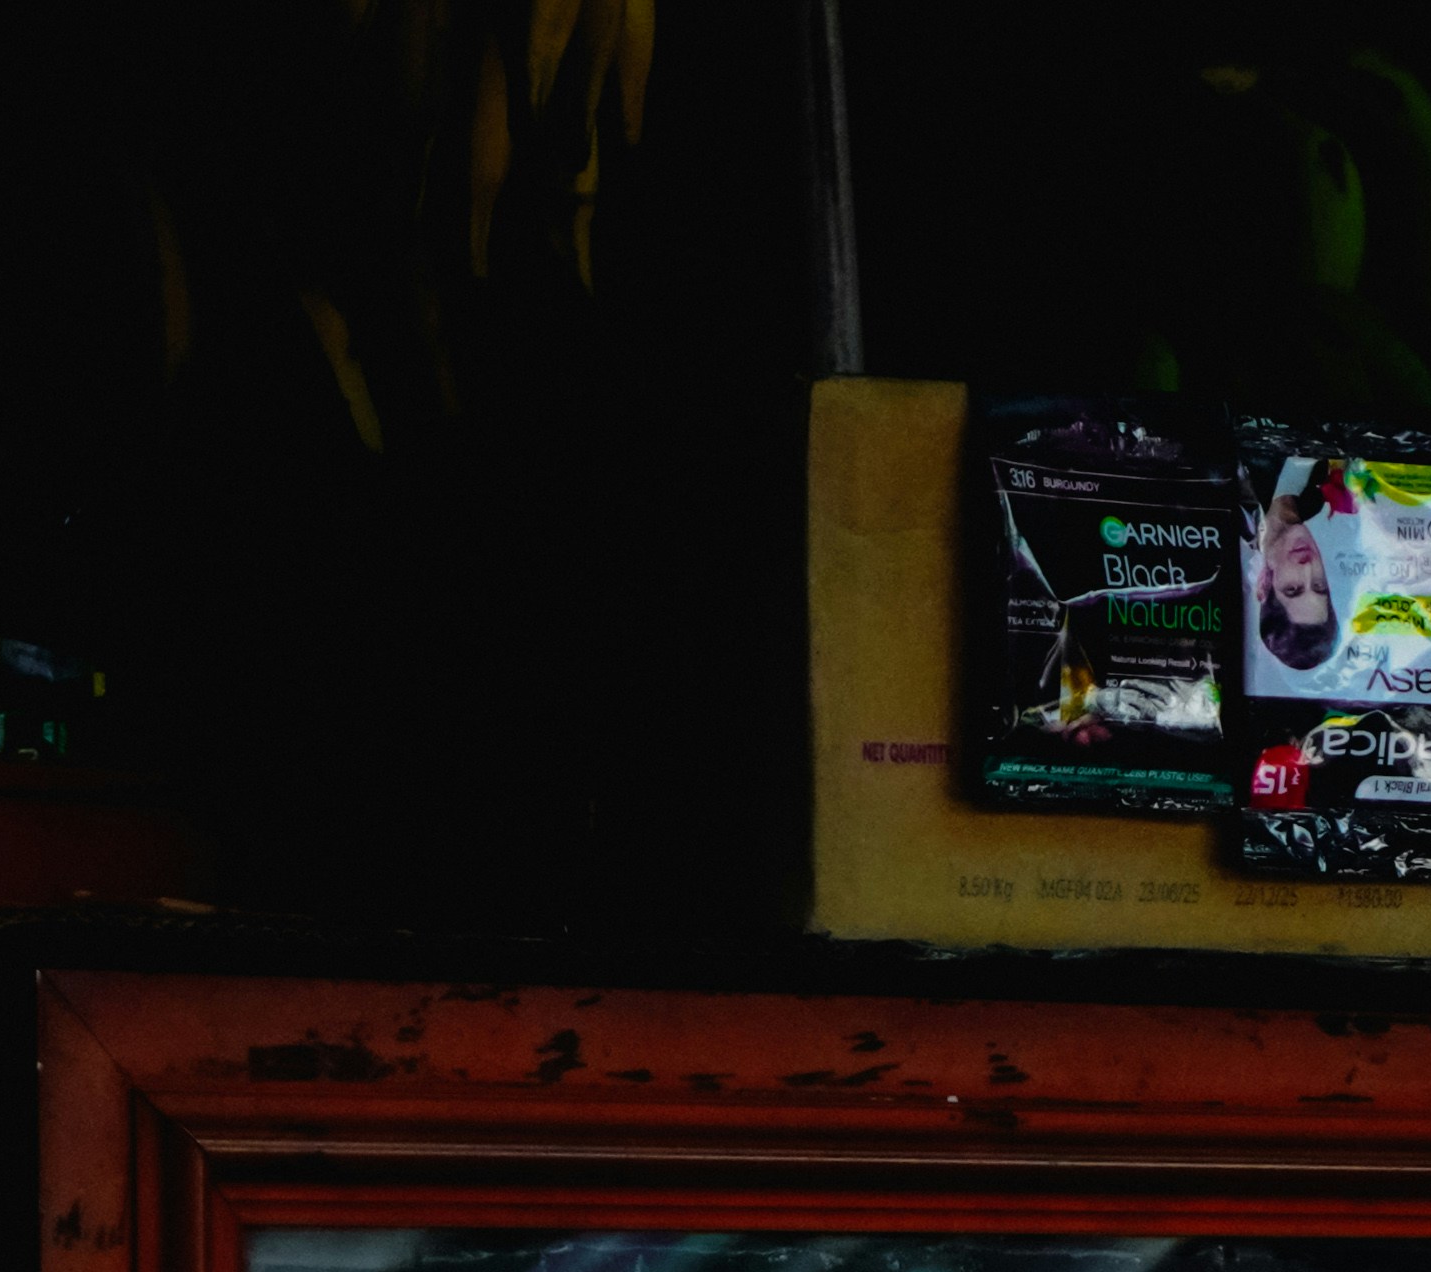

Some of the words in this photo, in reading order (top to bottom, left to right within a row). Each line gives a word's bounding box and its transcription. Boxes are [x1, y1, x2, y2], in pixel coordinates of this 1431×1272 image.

[1042, 476, 1101, 493] BURGUNDY
[1100, 518, 1222, 549] GARNIER
[1396, 525, 1425, 541] MIN
[1103, 553, 1188, 588] Black
[1107, 593, 1223, 632] Naturals
[1346, 645, 1390, 663] MEN
[863, 741, 885, 762] NET
[889, 741, 949, 764] QUANTIT
[999, 762, 1020, 773] NEW
[1050, 764, 1075, 775] SAME
[1384, 779, 1414, 794] Black
